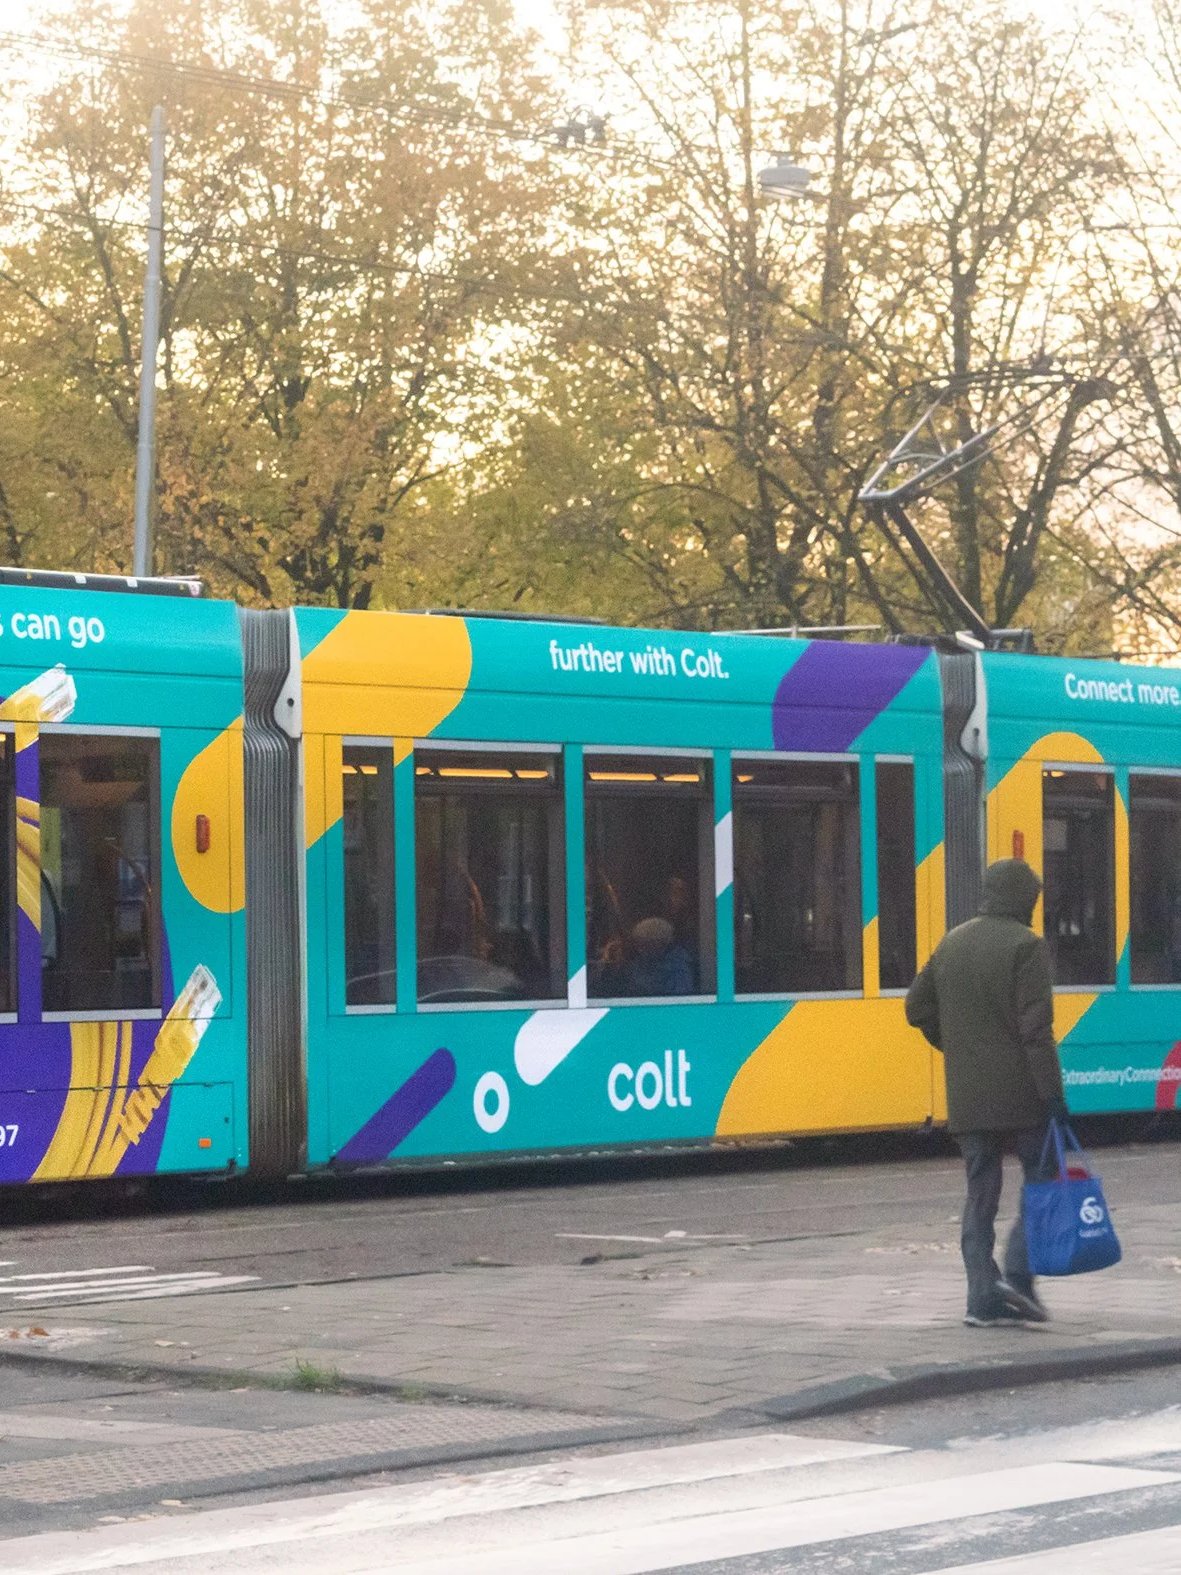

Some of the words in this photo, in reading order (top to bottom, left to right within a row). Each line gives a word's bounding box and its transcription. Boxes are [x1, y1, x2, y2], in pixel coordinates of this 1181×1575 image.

[11, 611, 60, 640] can
[69, 615, 105, 649] go
[549, 640, 624, 673] further
[629, 645, 676, 676] with
[681, 648, 730, 679] Colt.
[1065, 673, 1135, 703] Connect
[608, 1049, 692, 1112] colt
